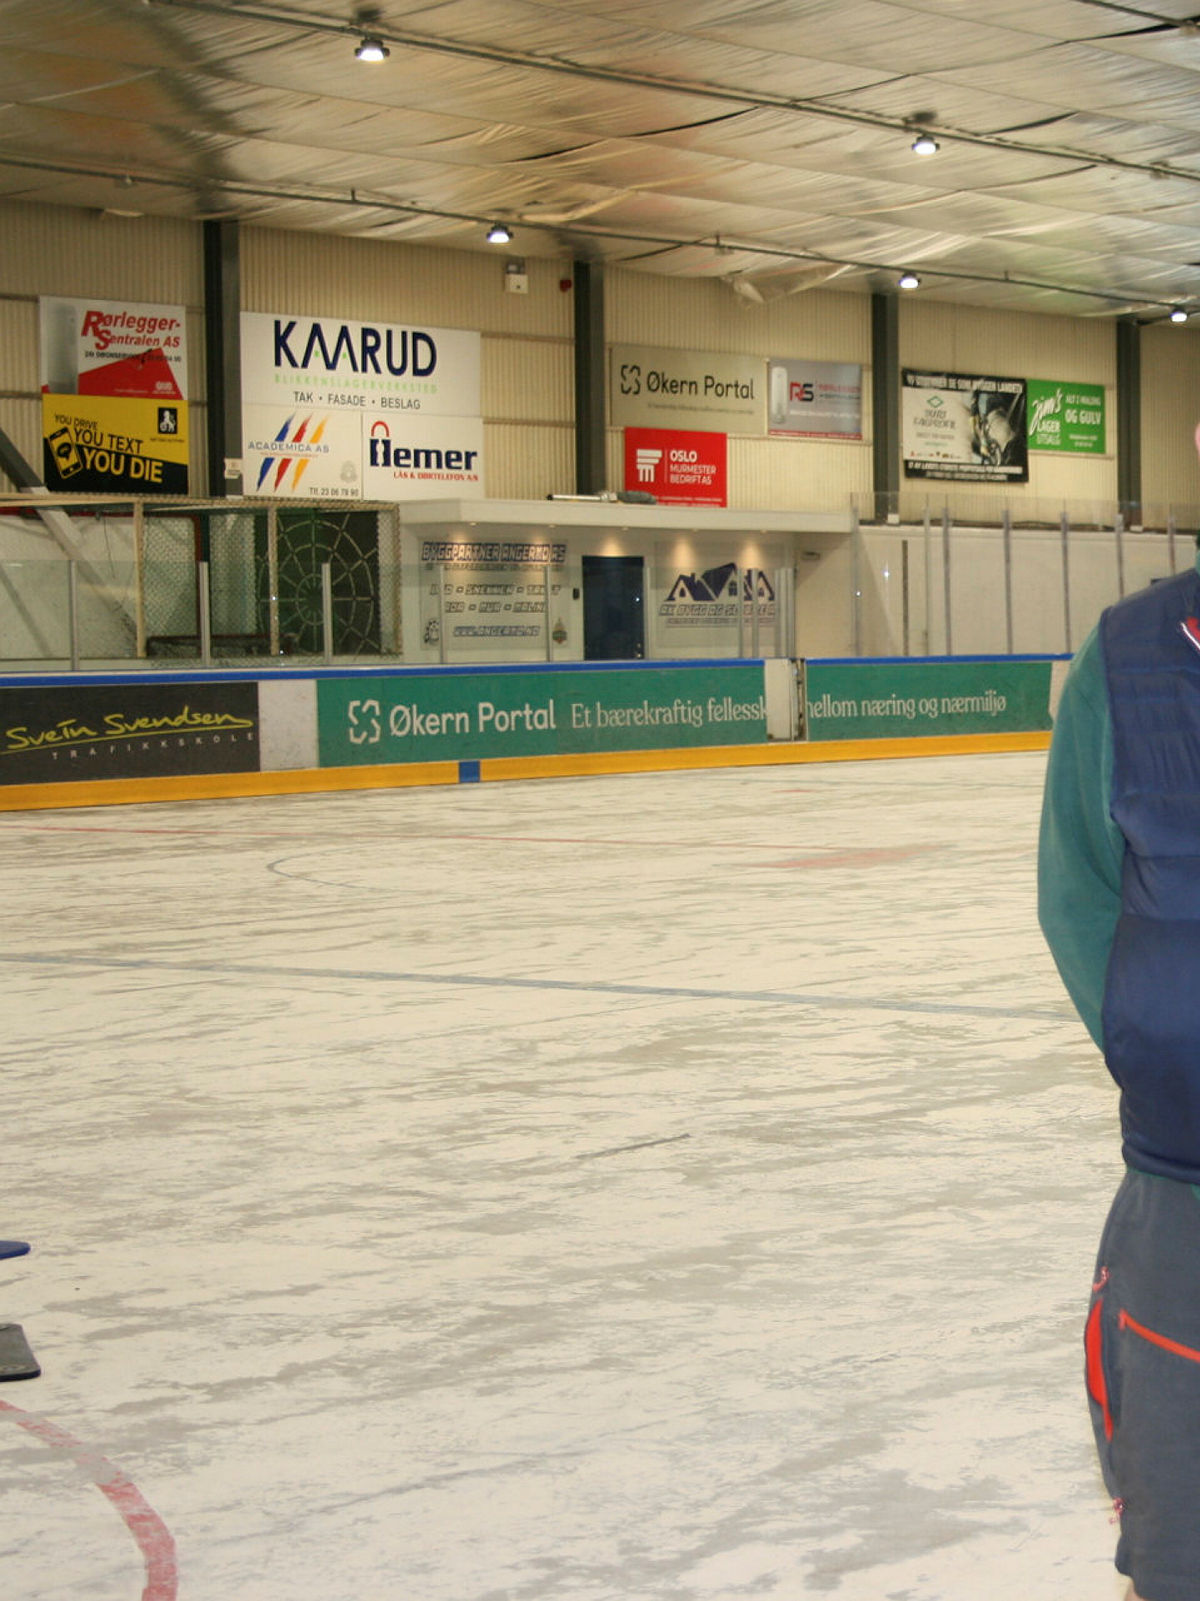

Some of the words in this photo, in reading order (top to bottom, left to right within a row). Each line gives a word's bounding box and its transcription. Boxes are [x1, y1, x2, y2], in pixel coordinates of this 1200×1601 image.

[81, 310, 180, 336] Rørlegger-
[95, 329, 160, 350] Sentralen
[163, 336, 181, 348] AS
[274, 320, 437, 377] KAARUD
[646, 371, 698, 396] Økern
[704, 375, 754, 399] Portal
[294, 391, 314, 402] TAK
[327, 393, 367, 407] FASADE
[381, 397, 421, 410] BESLAG
[55, 414, 72, 425] YOU
[74, 417, 98, 429] DRIVE
[74, 427, 104, 447] YOU
[107, 433, 143, 454] TEXT
[248, 441, 312, 452] ACADEMICA
[315, 444, 330, 453] AS
[83, 447, 125, 475] YOU
[129, 456, 164, 483] DIE
[670, 450, 697, 462] OSLO
[390, 703, 470, 736] Økern
[478, 699, 556, 732] Portal
[571, 703, 591, 728] Et
[597, 699, 703, 727] bærekraftig
[861, 694, 915, 719] næring
[919, 698, 938, 718] og
[941, 690, 1006, 716] nærmiljø
[104, 705, 253, 734] Svendsen
[52, 733, 254, 760] TRAFIKKSKOLE
